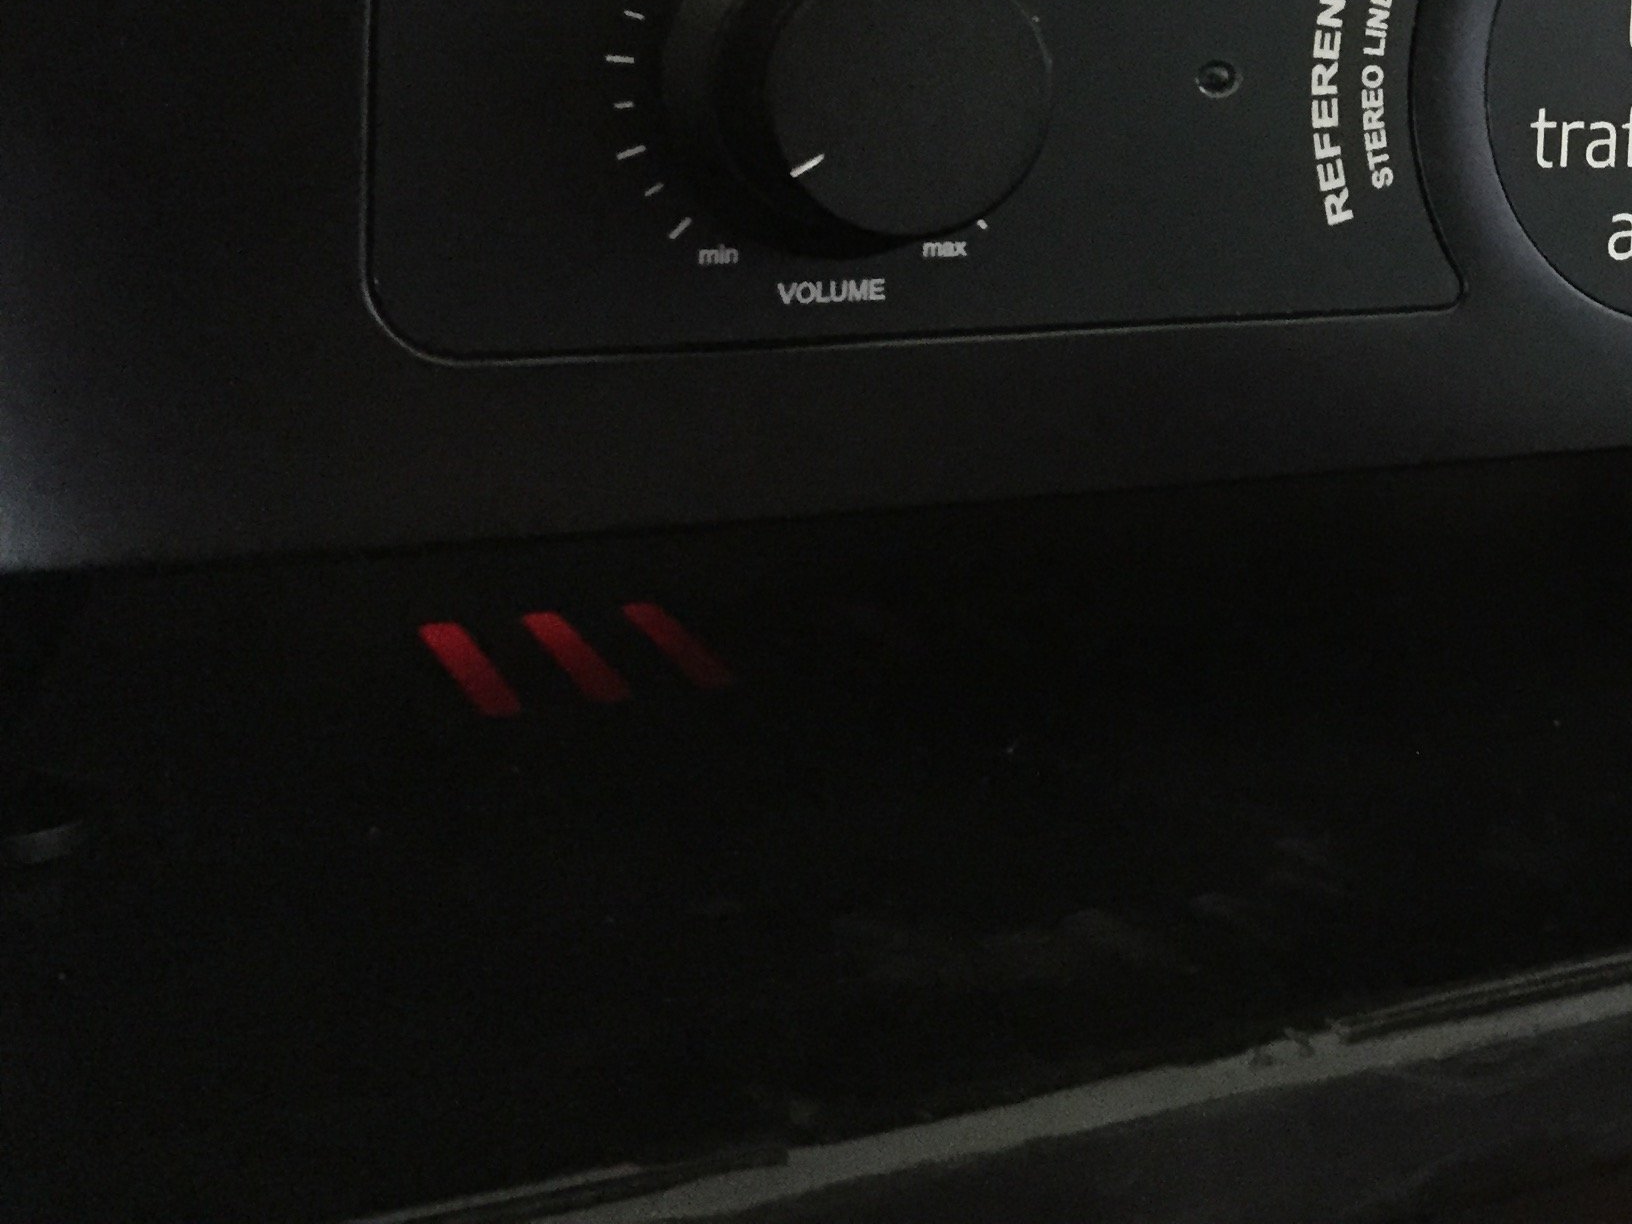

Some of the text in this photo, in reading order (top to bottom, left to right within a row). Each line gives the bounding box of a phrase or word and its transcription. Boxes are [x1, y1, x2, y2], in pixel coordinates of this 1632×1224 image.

[1360, 64, 1394, 190] STEREO
[698, 243, 740, 266] min
[922, 240, 968, 259] max
[776, 277, 887, 306] VOLUME
